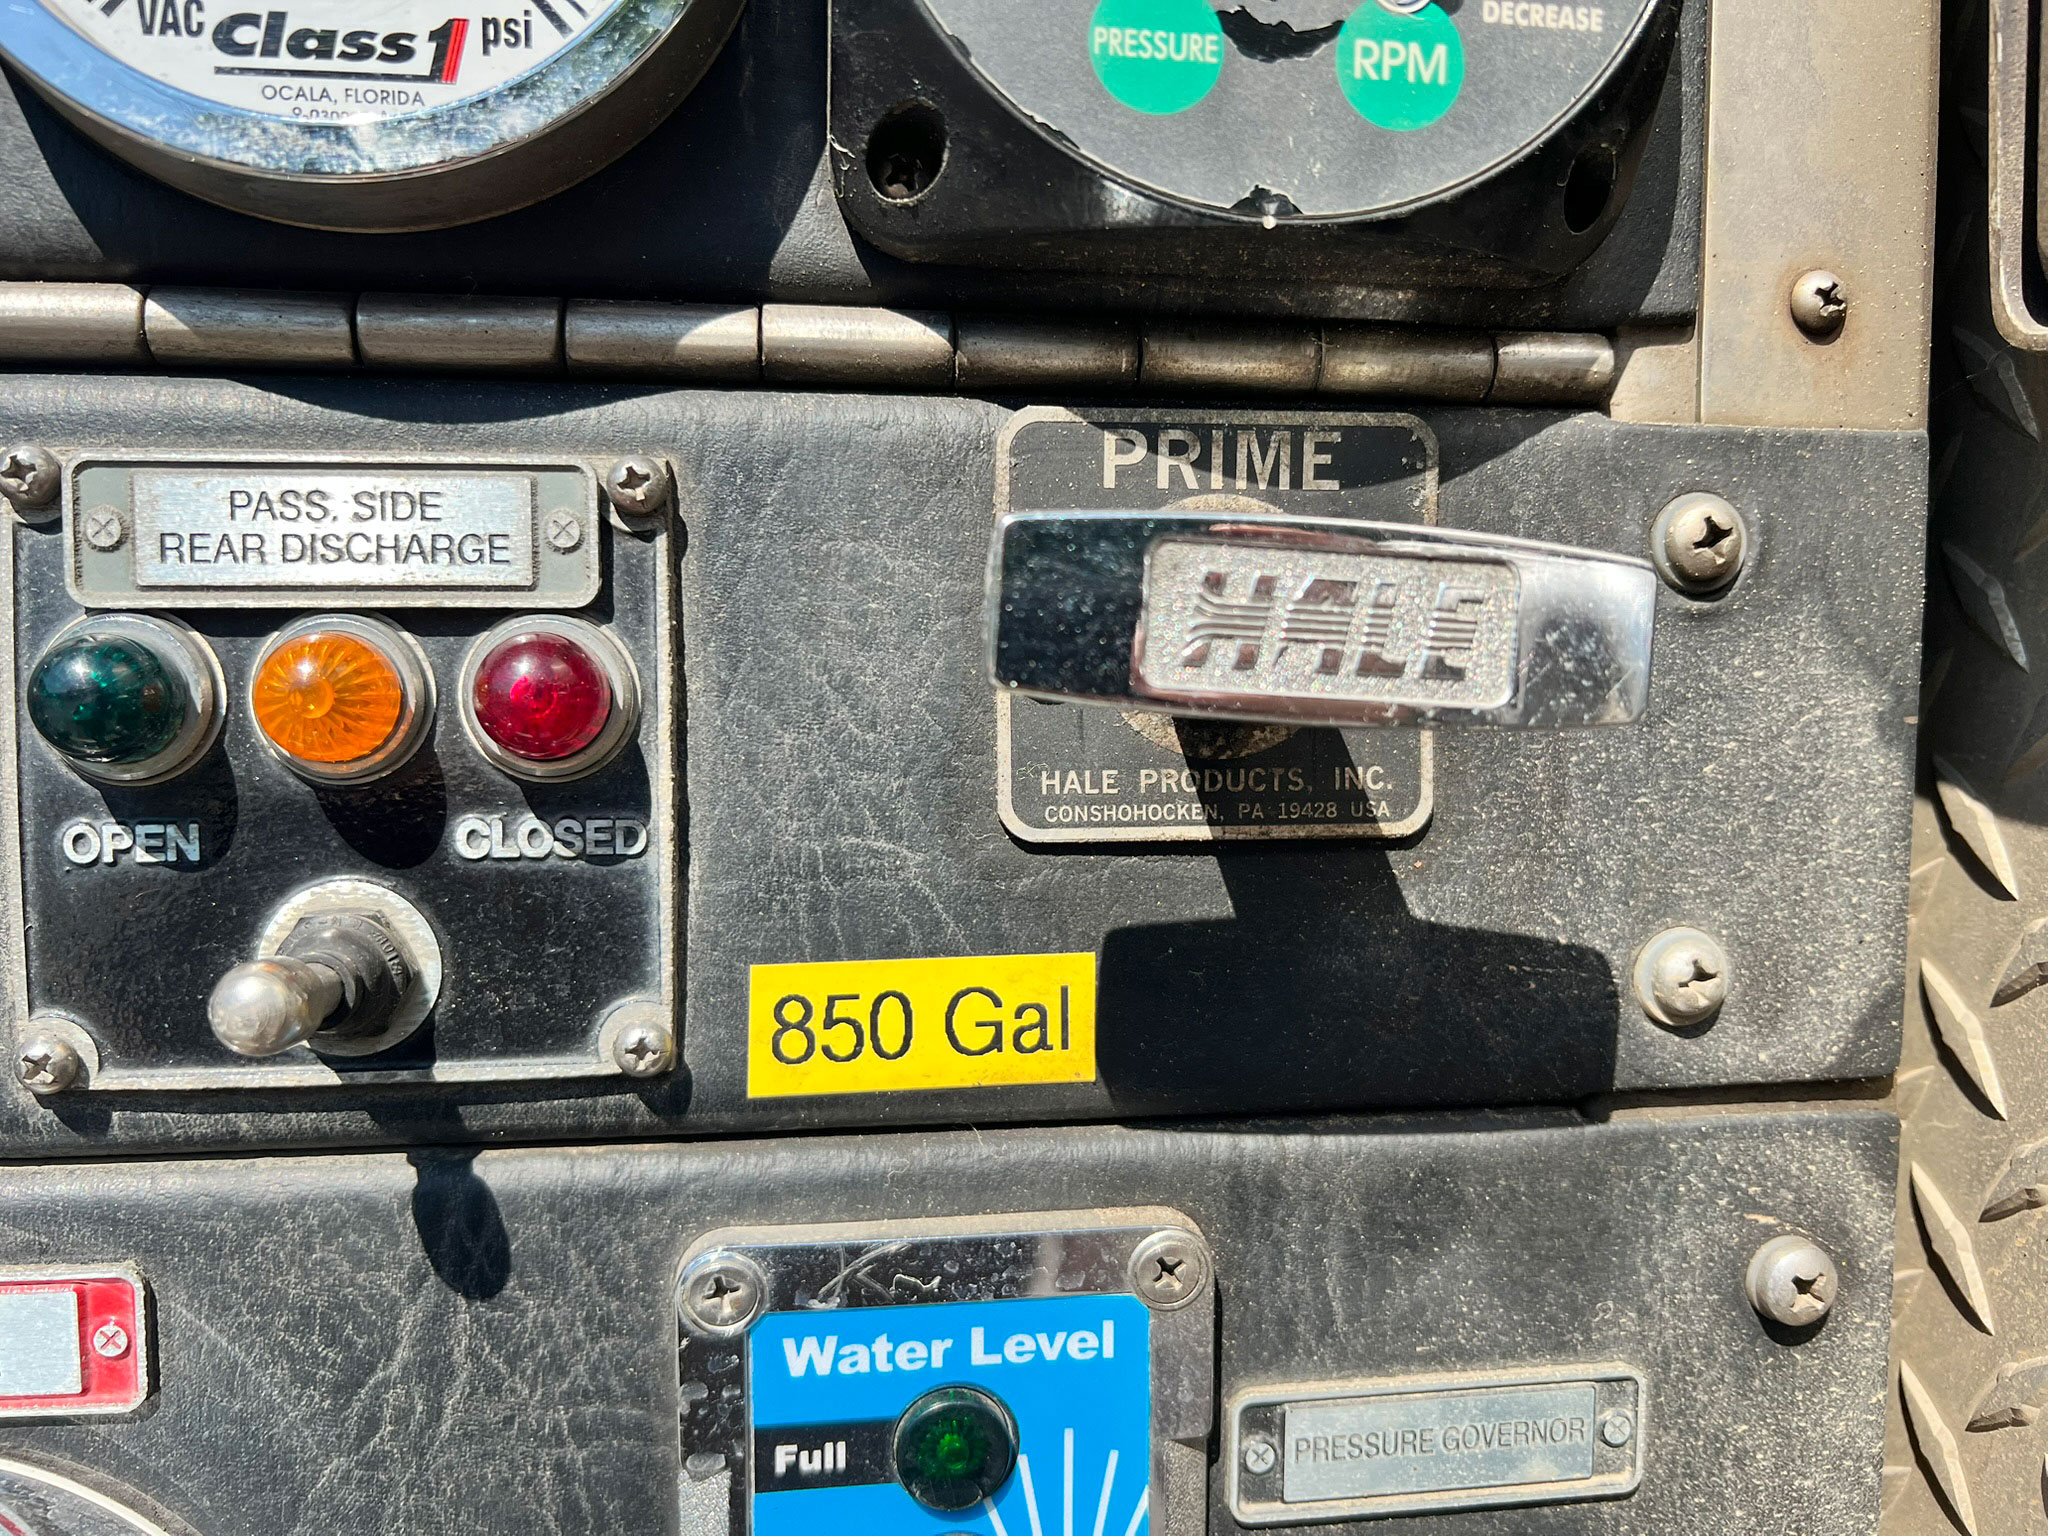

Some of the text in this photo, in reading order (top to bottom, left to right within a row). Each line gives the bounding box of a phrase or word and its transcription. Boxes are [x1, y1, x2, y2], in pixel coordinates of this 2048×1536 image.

[138, 0, 205, 38] VAC
[481, 11, 533, 56] psi
[1482, 0, 1604, 32] DECREASE
[1093, 27, 1220, 64] PRESSURE
[1352, 38, 1448, 86] RPM
[261, 84, 425, 106] OCALA, FLORIDA
[1101, 430, 1342, 492] PRIME
[229, 490, 443, 522] PASS. SIDE
[159, 533, 511, 565] REAR DISCHARGE
[1041, 765, 1394, 796] HALE PRODUCTS, INC.
[1044, 800, 1391, 824] CONSHOHOCKEN, PA 19428 USA
[61, 822, 201, 866] OPEN
[454, 816, 648, 862] CLOSED
[771, 985, 1071, 1065] 850 Gal
[783, 1320, 1114, 1378] Water Level
[773, 1440, 847, 1477] Full
[1295, 1417, 1586, 1464] PRESSURE GOVERNOR
